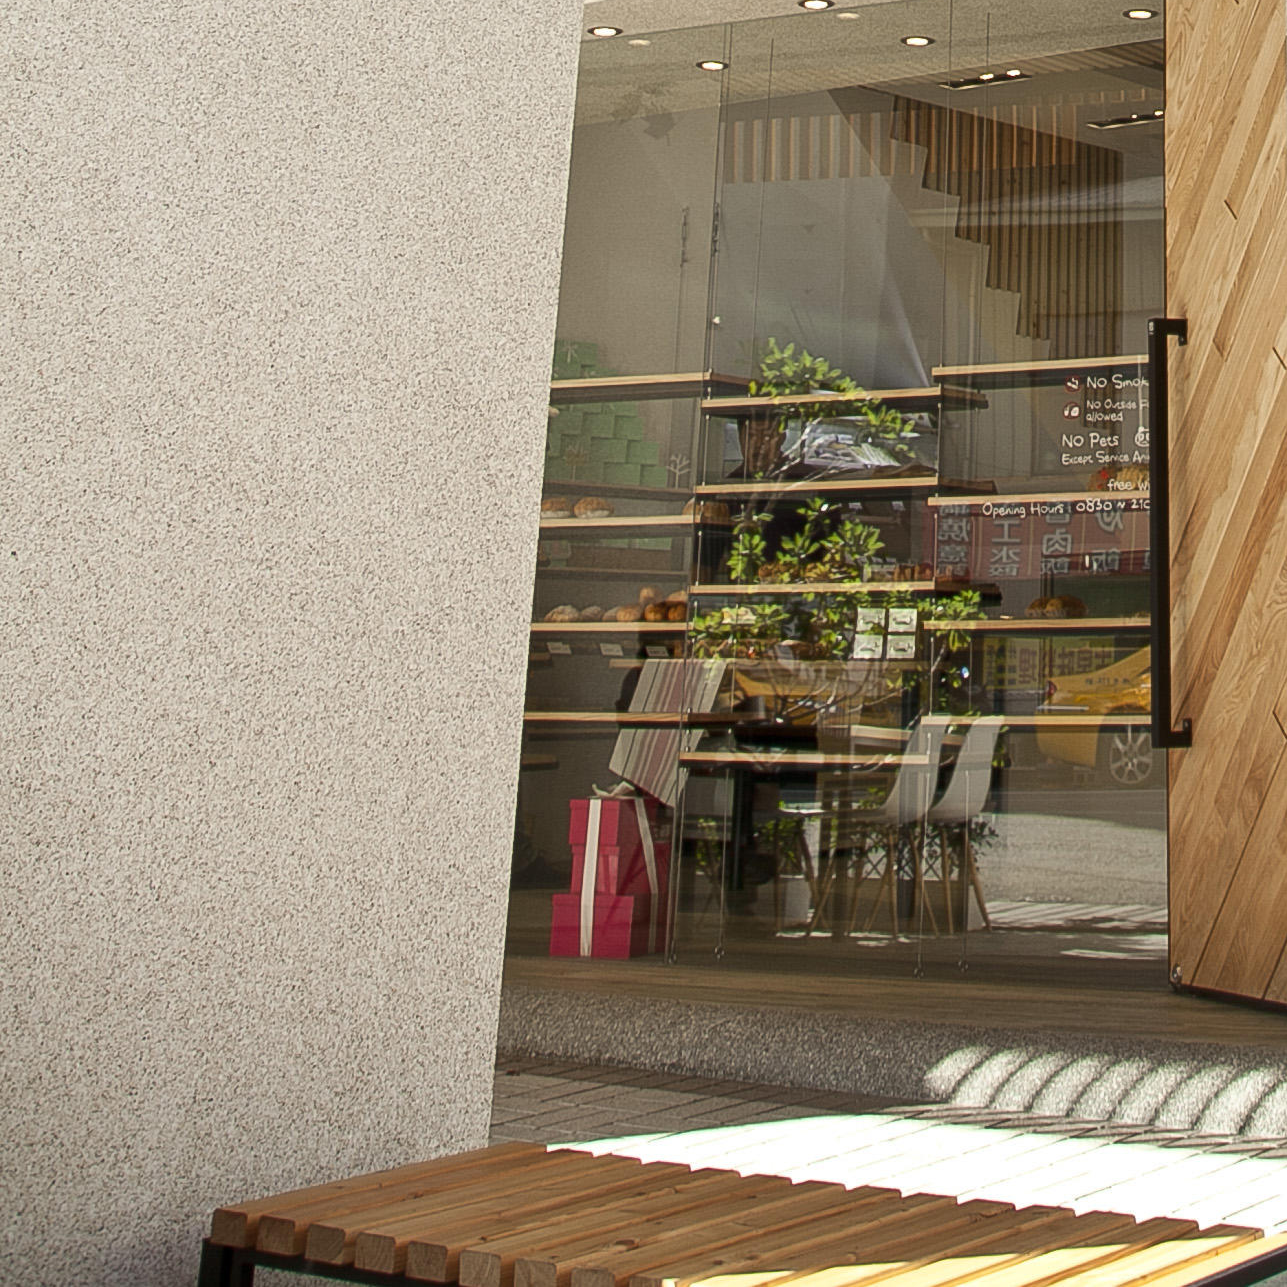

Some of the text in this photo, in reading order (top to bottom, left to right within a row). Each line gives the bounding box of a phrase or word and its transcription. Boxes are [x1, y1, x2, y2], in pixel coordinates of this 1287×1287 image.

[1112, 374, 1150, 389] Smok
[1089, 432, 1119, 449] Pets
[1107, 478, 1132, 492] free
[982, 501, 1026, 519] Opening
[1076, 497, 1112, 512] 0830
